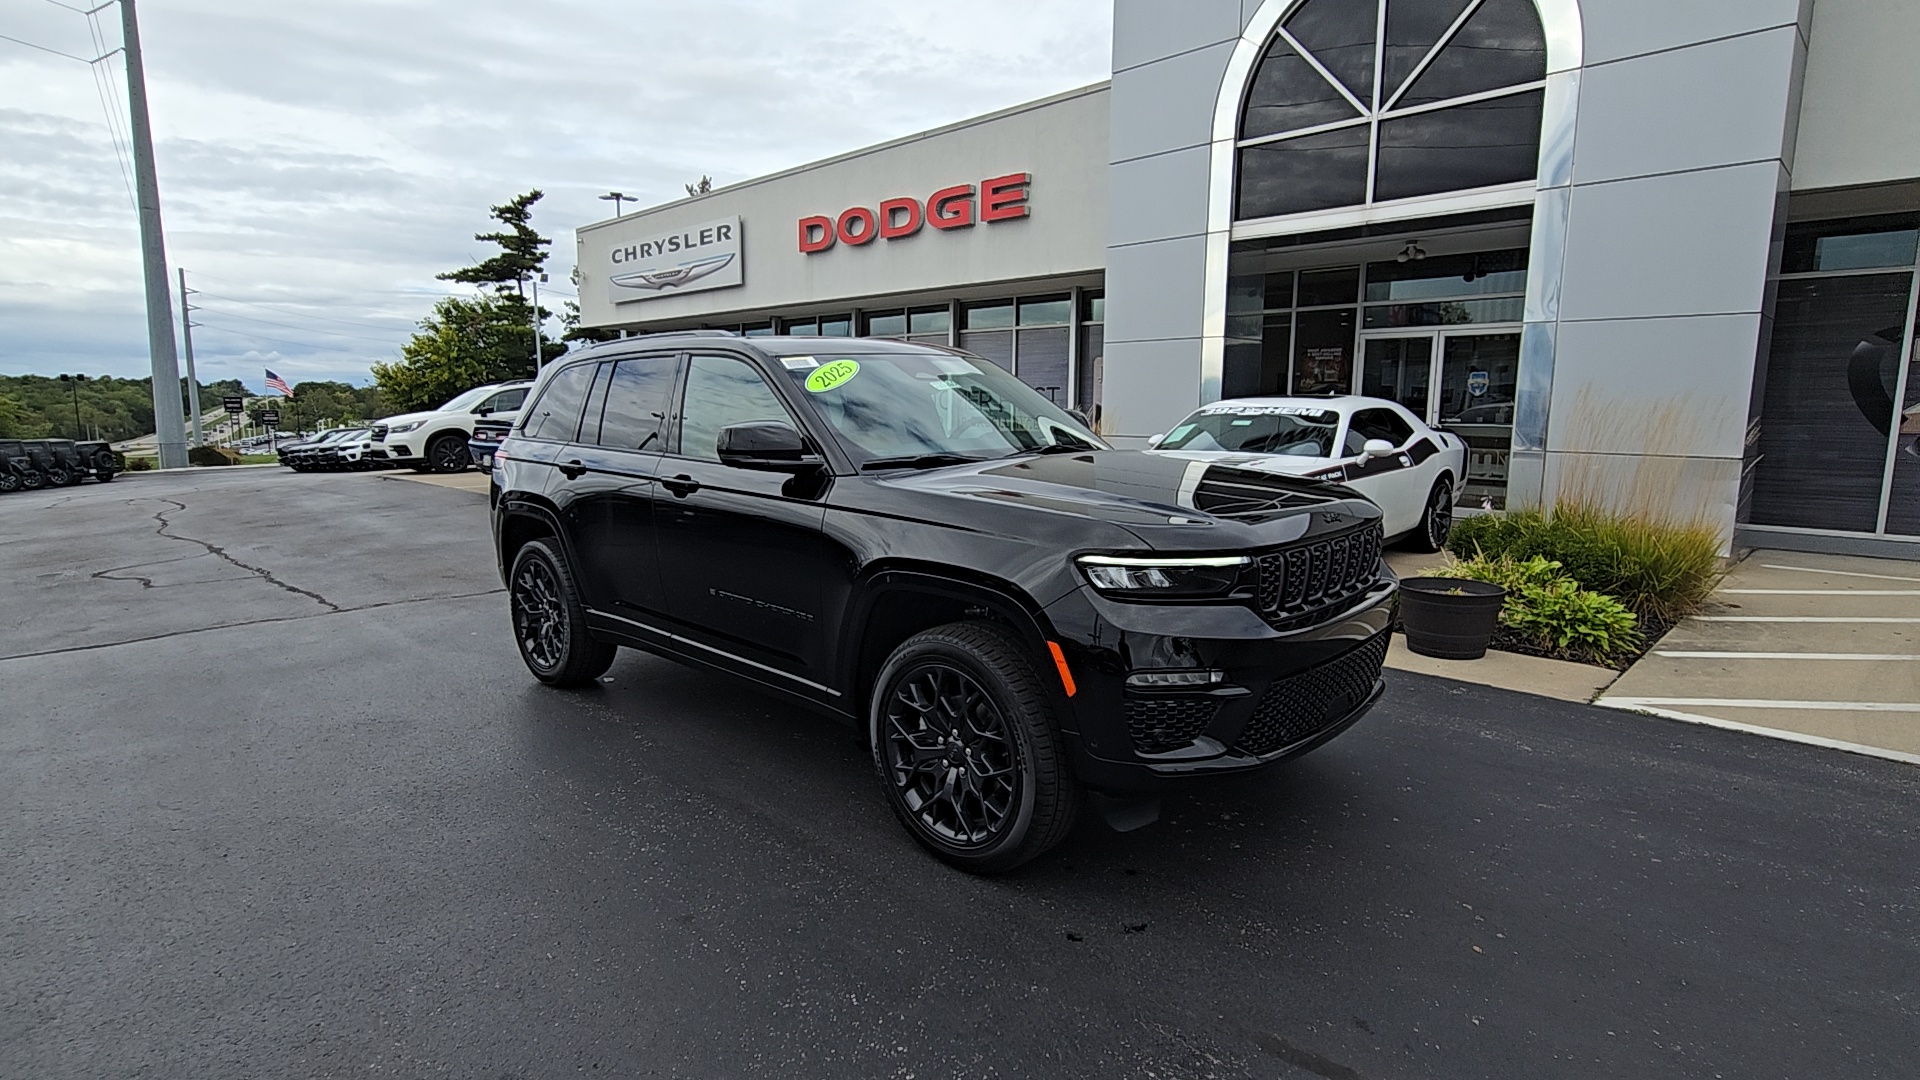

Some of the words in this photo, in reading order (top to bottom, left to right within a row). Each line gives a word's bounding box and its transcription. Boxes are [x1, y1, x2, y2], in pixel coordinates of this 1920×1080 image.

[798, 172, 1031, 254] DODGE
[611, 224, 732, 264] CHRYSLER
[815, 362, 852, 388] 2025
